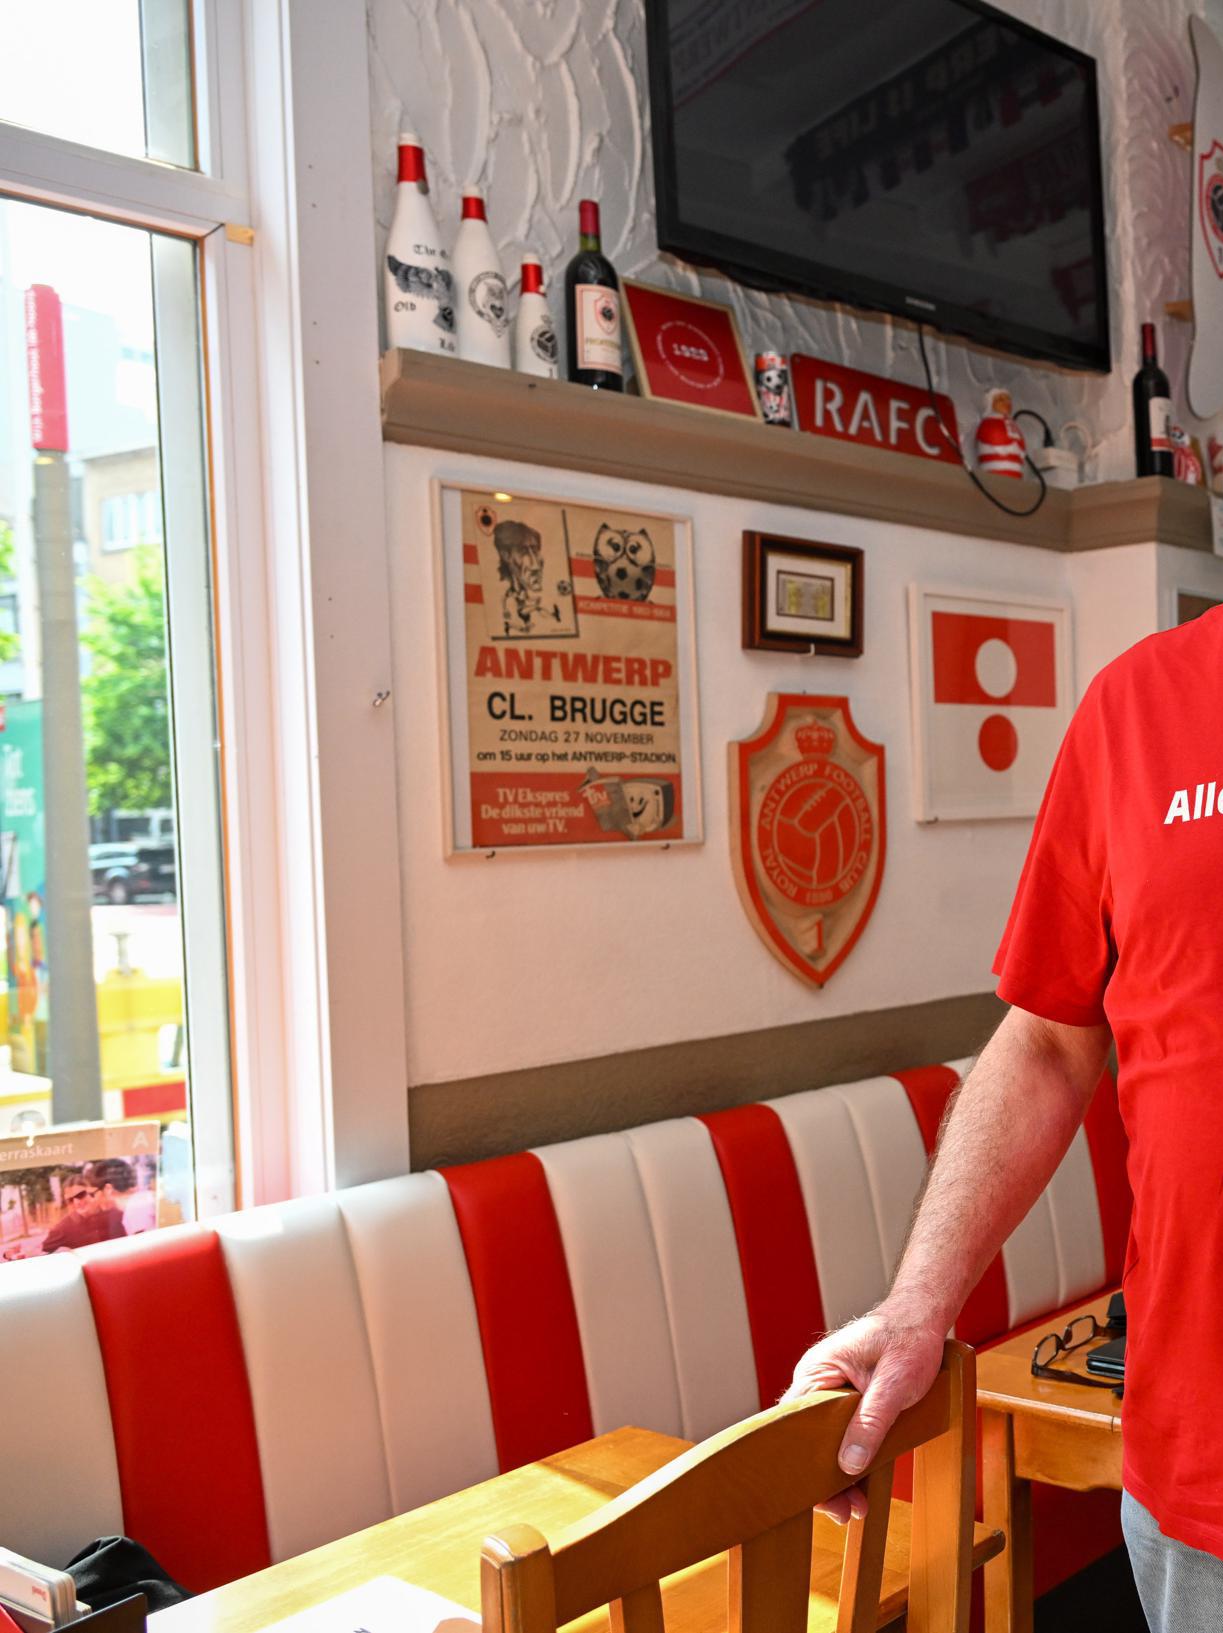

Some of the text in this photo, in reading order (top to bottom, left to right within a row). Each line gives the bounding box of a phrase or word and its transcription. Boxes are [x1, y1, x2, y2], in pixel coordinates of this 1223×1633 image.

[815, 378, 942, 456] RAFC
[474, 646, 672, 687] ANTWERP
[487, 691, 665, 727] CL. BRUGGE
[499, 729, 654, 745] ZONDAG 27 NOVEMBER
[476, 750, 677, 766] om 15 uur op het ANTWERP-STADION
[496, 788, 570, 805] TV Ekspres
[761, 763, 818, 830] ANTWERP
[824, 764, 871, 841] FOOTBALL
[480, 805, 501, 819] De
[544, 803, 585, 818] vriend
[501, 822, 527, 834] van
